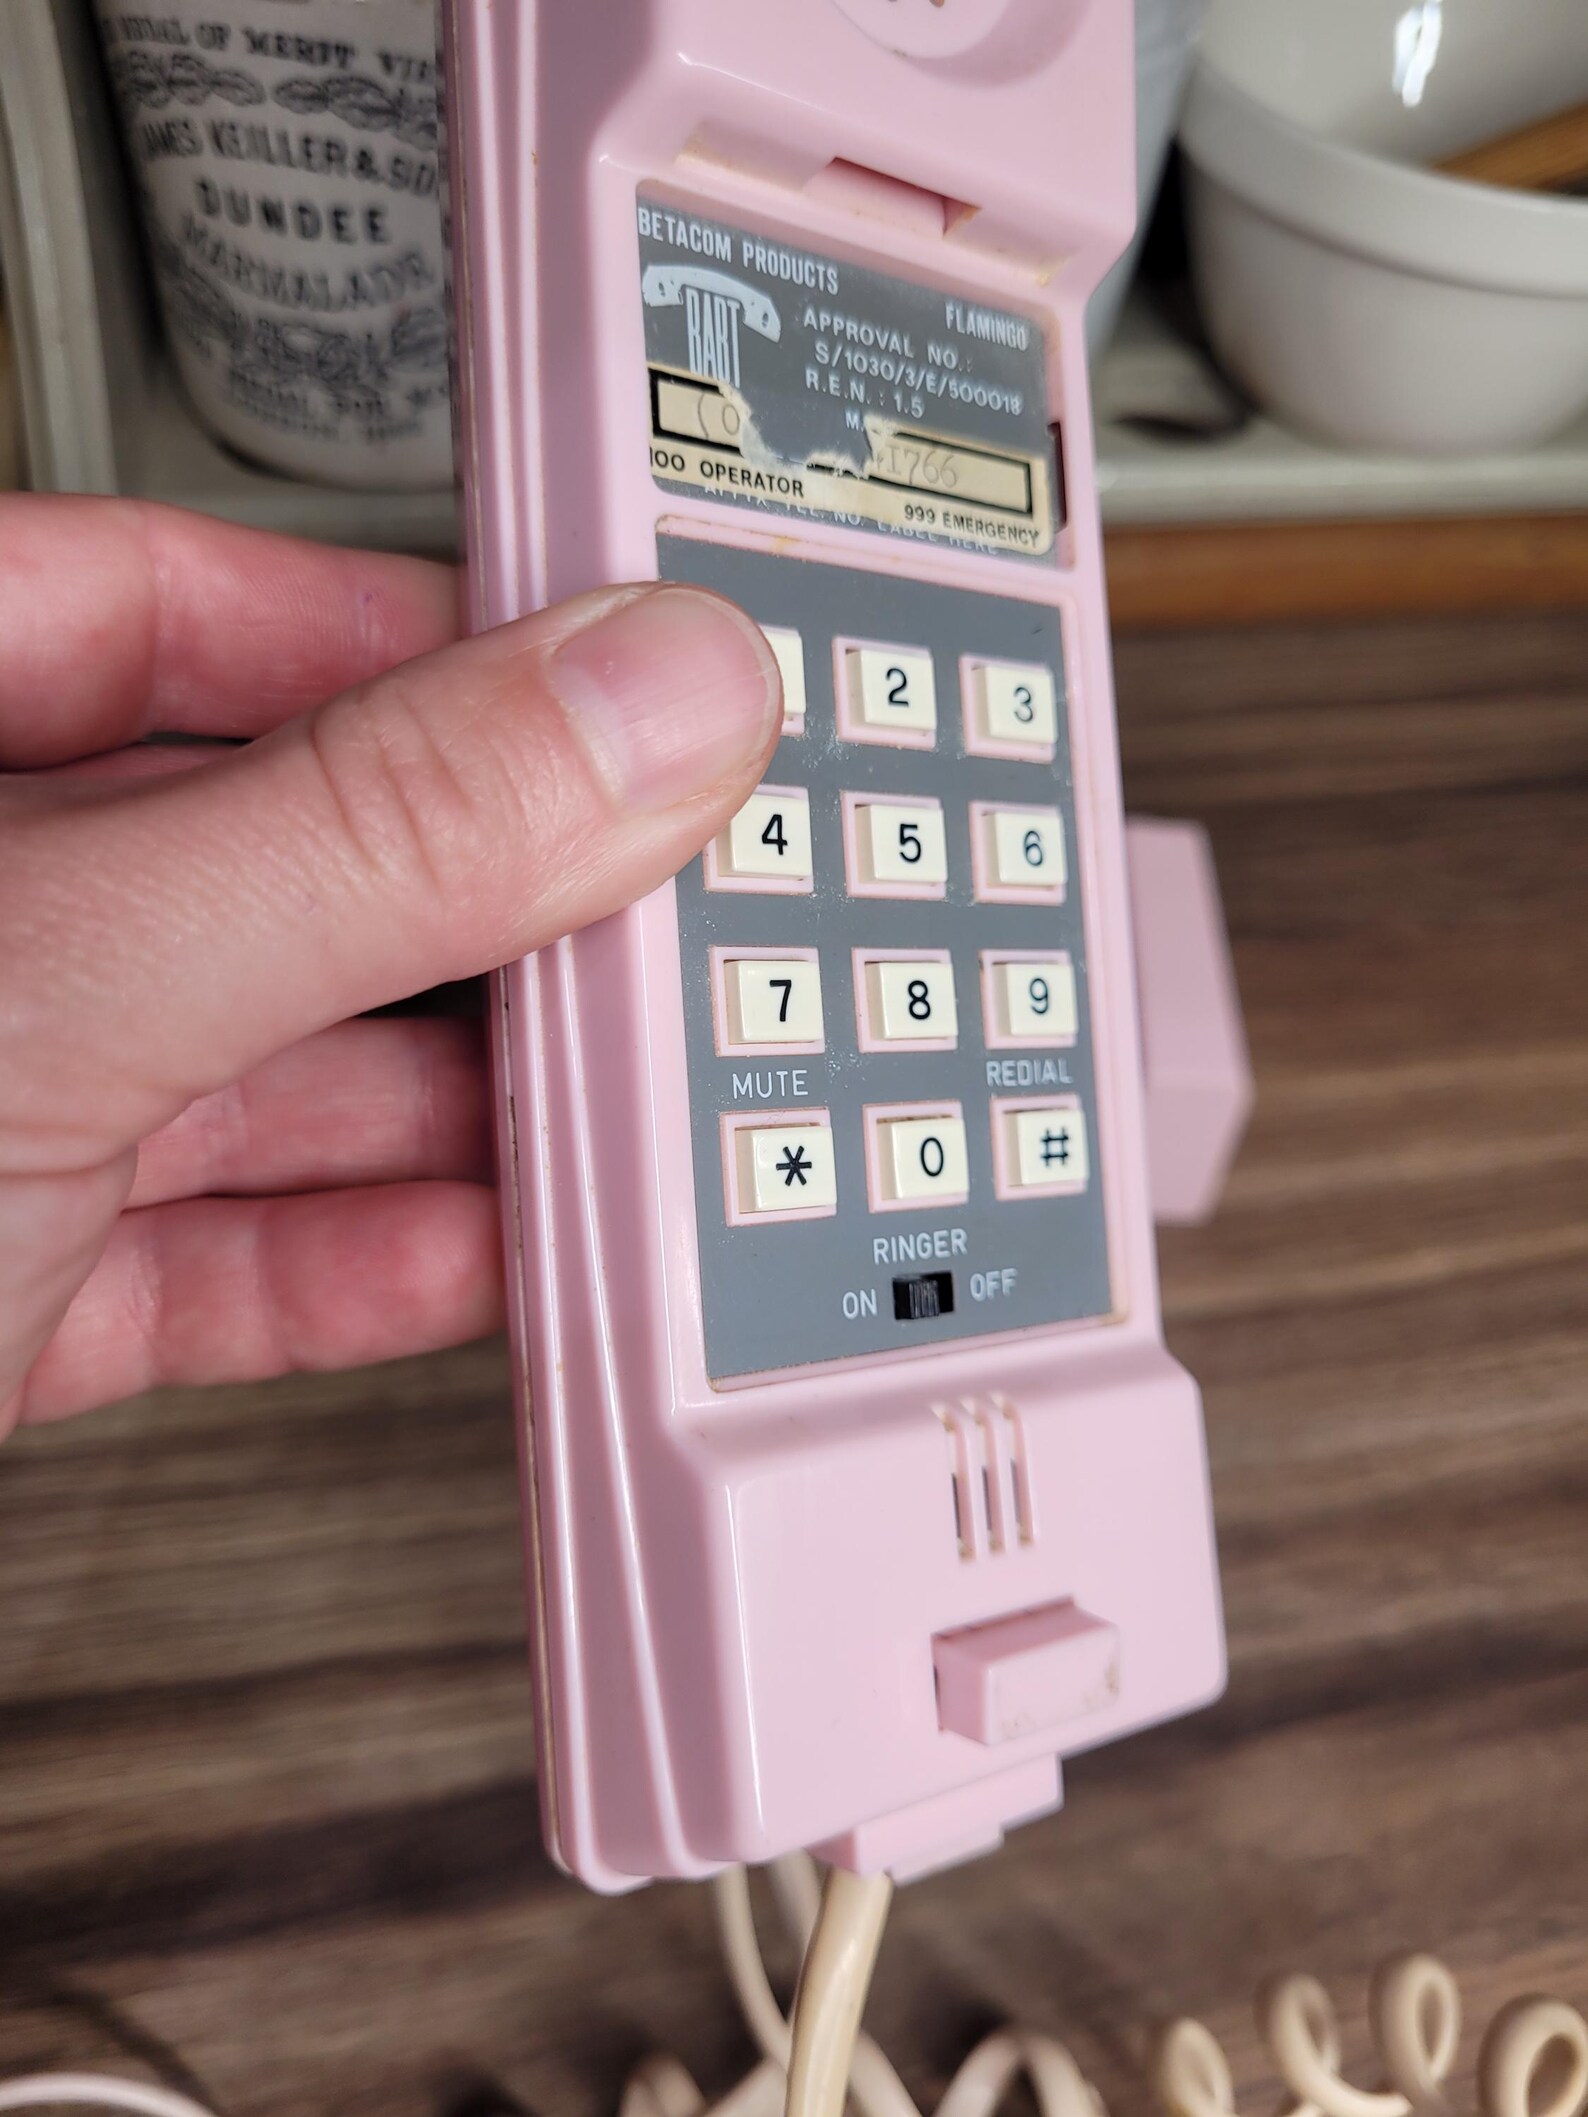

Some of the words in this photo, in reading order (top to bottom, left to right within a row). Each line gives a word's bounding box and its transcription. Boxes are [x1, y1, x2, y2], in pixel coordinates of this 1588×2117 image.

[243, 26, 356, 69] MERIT
[194, 175, 394, 246] DUNDEE
[638, 207, 732, 264] BETACOM
[742, 239, 840, 296] PRODUCTS
[803, 308, 915, 359] APPROVAL
[944, 300, 1030, 352] FLAMINGO
[894, 390, 925, 419] 1.5
[700, 460, 805, 498] OPERATOR
[904, 503, 936, 525] 999
[942, 510, 1040, 548] EMERGENCY
[885, 668, 910, 708] 2
[1012, 687, 1034, 723] 3
[761, 814, 788, 856] 4
[899, 823, 922, 863] 5
[1023, 830, 1045, 868] 6
[768, 979, 793, 1022] 7
[907, 979, 931, 1020] 8
[1029, 977, 1050, 1015] 9
[732, 1069, 809, 1099] MUTE
[985, 1059, 1073, 1088] REDIAL
[919, 1137, 945, 1177] 0
[873, 1228, 969, 1265] RINGER
[842, 1289, 878, 1319] ON
[969, 1267, 1018, 1300] OFF
